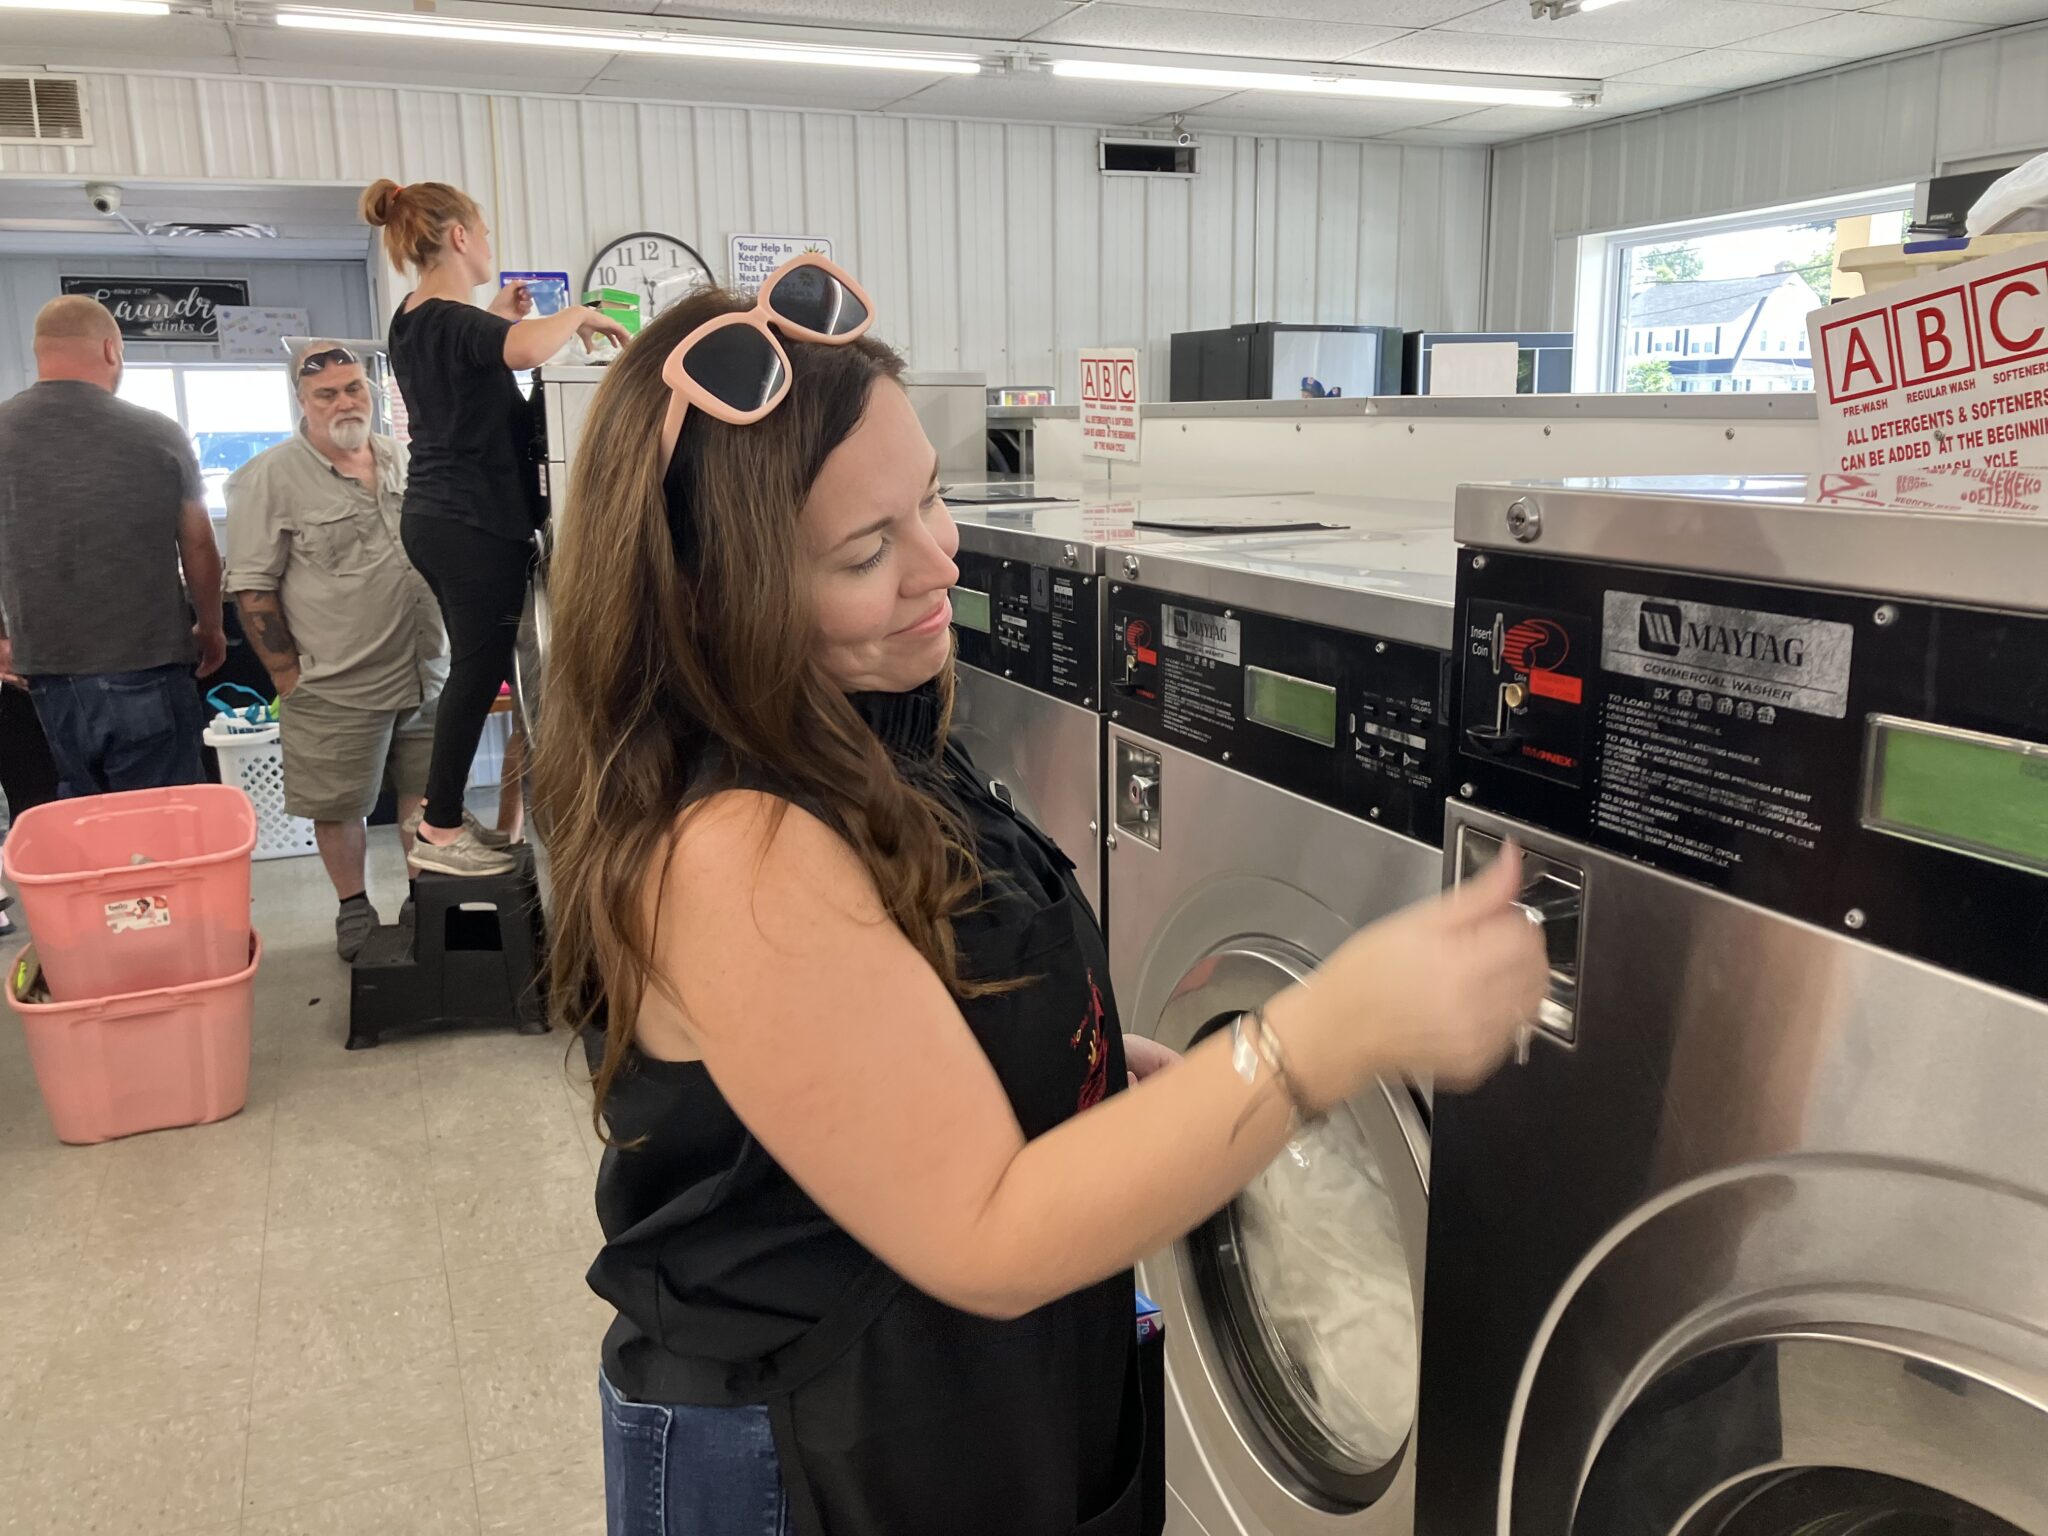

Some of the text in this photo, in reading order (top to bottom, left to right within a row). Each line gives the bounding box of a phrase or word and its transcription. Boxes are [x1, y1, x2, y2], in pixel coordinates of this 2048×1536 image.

[616, 247, 636, 266] 11
[639, 241, 659, 260] 12
[670, 248, 680, 268] 1
[738, 242, 792, 254] Your Help In
[738, 252, 773, 264] Keeping
[598, 266, 617, 286] 10
[739, 262, 756, 272] This
[739, 273, 760, 282] Neat
[152, 320, 194, 332] stinks
[1990, 281, 2046, 352] C
[1916, 306, 1952, 374] B
[1842, 326, 1884, 392] A
[1084, 364, 1095, 396] A
[1103, 366, 1111, 397] B
[1120, 366, 1132, 398] C
[1993, 362, 2048, 384] SOFTENERS
[1906, 378, 1976, 403] REGULAR WASH
[1844, 398, 1888, 417] PRE-WASH
[1847, 388, 2048, 446] ALL DETERGENTS & SOFTENERS
[1841, 453, 1865, 471] CAN
[1869, 450, 1885, 466] BE
[1889, 440, 1931, 464] ADDED
[1939, 436, 1953, 455] AT
[1957, 431, 1983, 450] THE
[1470, 625, 1492, 640] Insert
[1472, 643, 1489, 656] Coin
[1686, 622, 1805, 667] MAYTAG
[1644, 662, 1793, 700] COMMERCIAL WASHER
[1608, 694, 1622, 702] TO
[1623, 697, 1651, 709] LOAD
[1605, 734, 1618, 742] TO
[1620, 737, 1640, 748] FILL
[1601, 793, 1612, 801] TO
